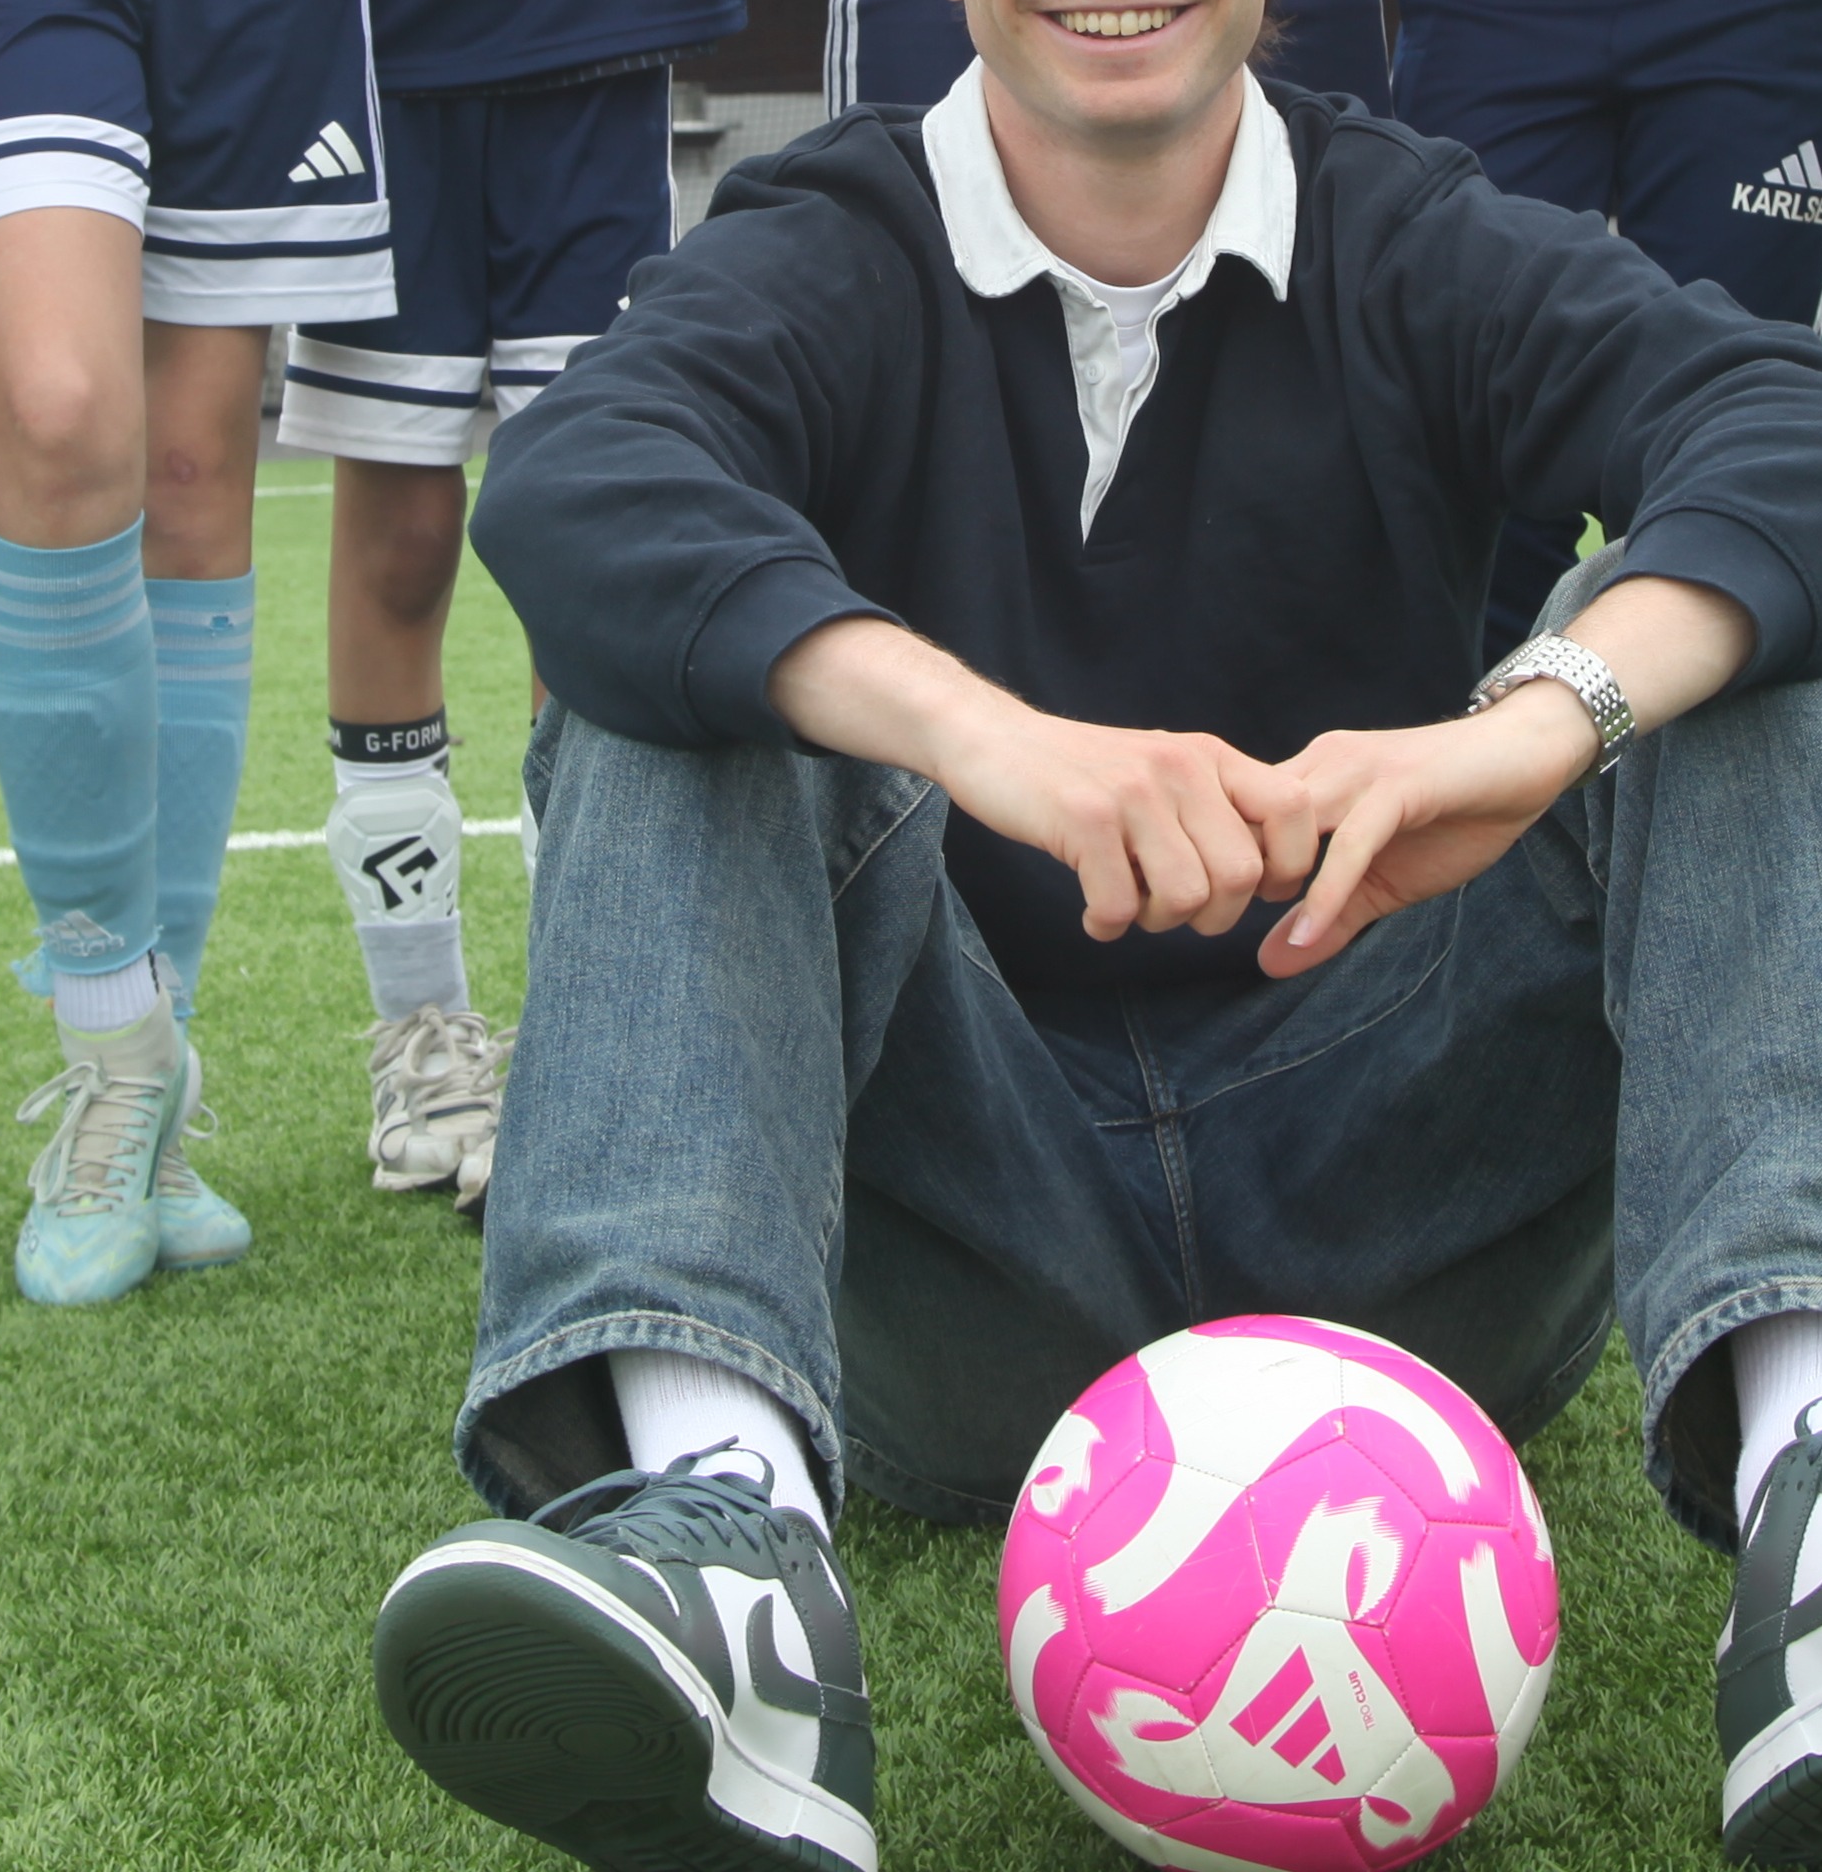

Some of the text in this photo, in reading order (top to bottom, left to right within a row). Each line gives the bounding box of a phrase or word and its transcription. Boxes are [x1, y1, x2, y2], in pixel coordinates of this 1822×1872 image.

[365, 720, 442, 753] G-FORM
[1348, 1670, 1376, 1731] TIRO CLUB
